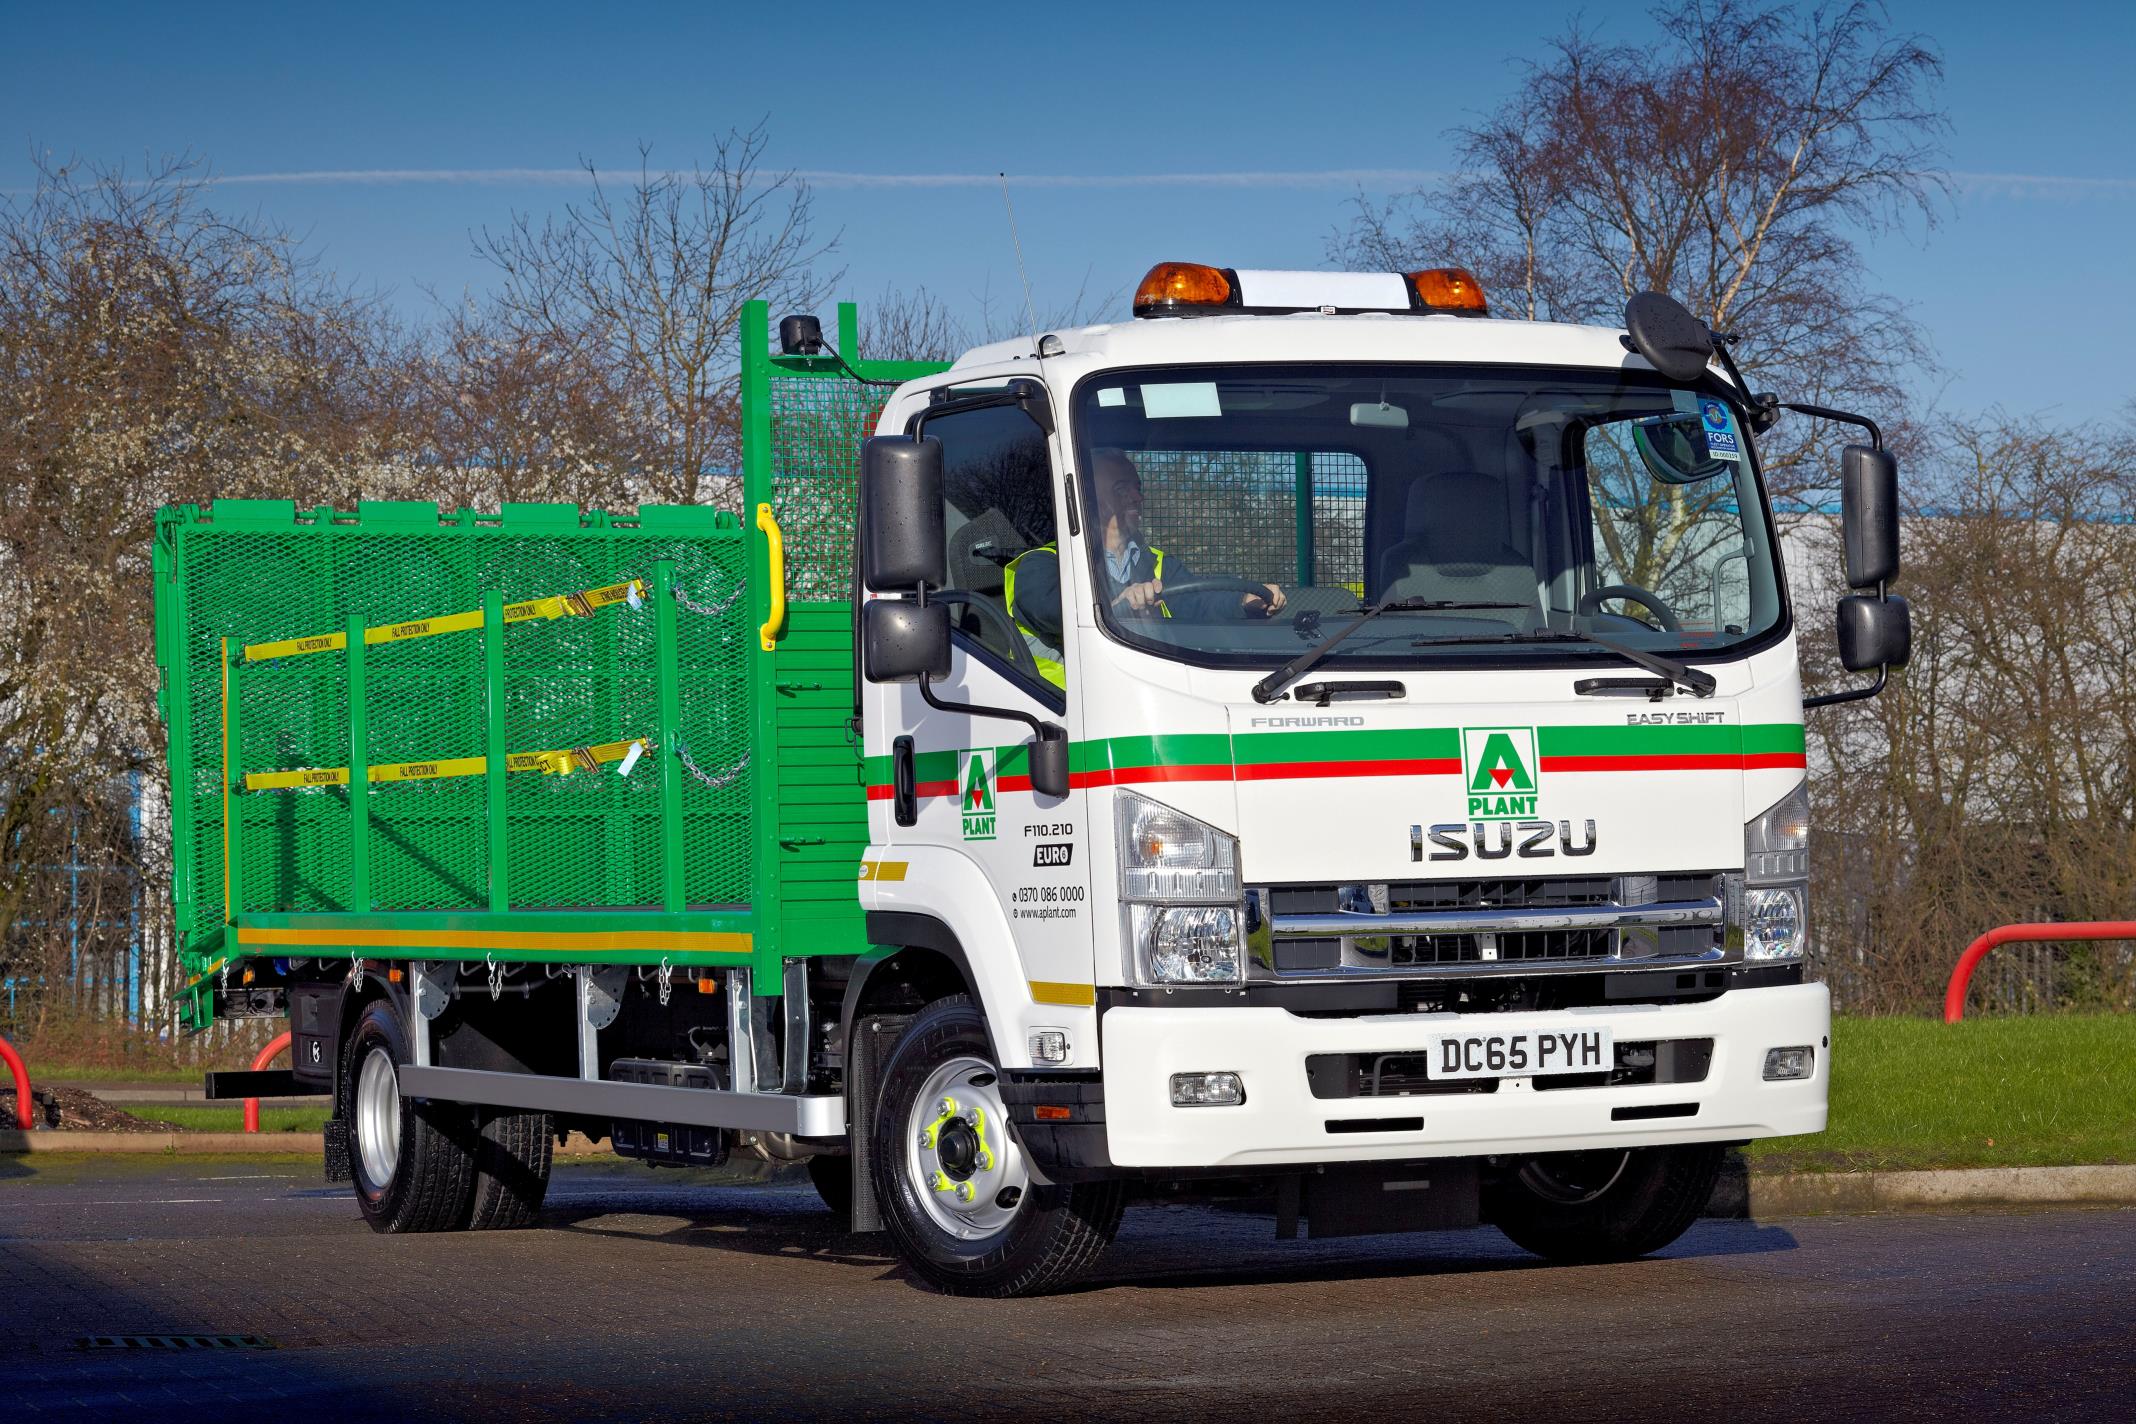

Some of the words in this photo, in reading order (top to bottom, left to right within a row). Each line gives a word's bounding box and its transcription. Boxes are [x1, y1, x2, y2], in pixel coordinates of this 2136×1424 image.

[1708, 432, 1734, 444] FORS
[392, 627, 400, 638] FALL
[401, 624, 420, 635] PROTECTION
[421, 623, 430, 633] ONLY
[297, 641, 305, 651] FALL
[305, 638, 324, 650] PROTECTION
[1251, 717, 1364, 727] FORWARD
[1471, 733, 1534, 790] A
[304, 773, 312, 783] FALL
[312, 772, 331, 783] PROTECTION
[400, 766, 408, 777] FALL
[409, 765, 429, 776] PROTECTION
[429, 764, 437, 775] ONLY
[963, 754, 993, 811] A
[1468, 796, 1538, 816] PLANT
[963, 817, 996, 835] PLANT
[1024, 823, 1073, 837] F110.210
[1410, 819, 1596, 862] ISUZU
[1019, 887, 1038, 902] 0370
[1040, 887, 1057, 902] 086
[1060, 886, 1085, 902] 0000
[1020, 905, 1077, 922] www.aplant.com
[1441, 1035, 1528, 1073] DC65
[1538, 1032, 1600, 1068] PYH
